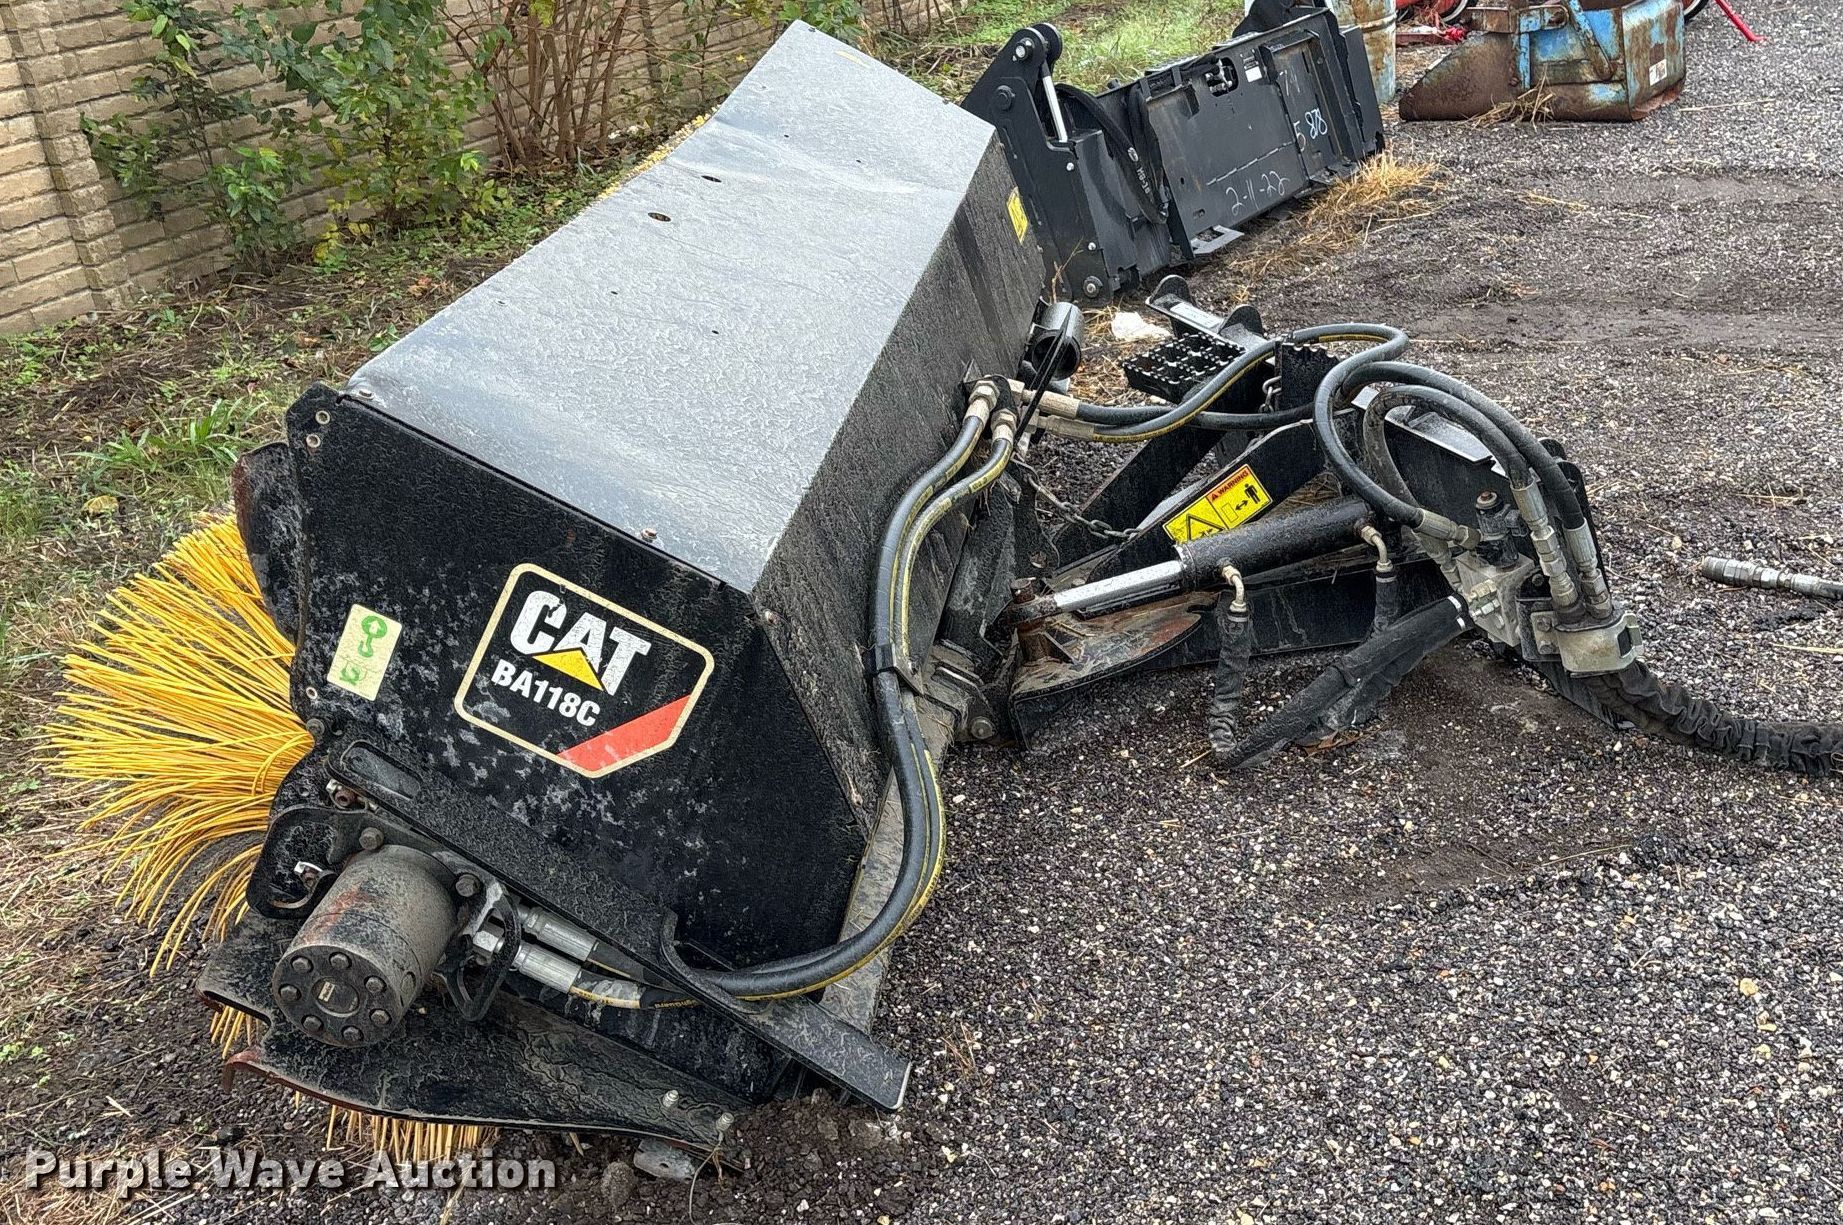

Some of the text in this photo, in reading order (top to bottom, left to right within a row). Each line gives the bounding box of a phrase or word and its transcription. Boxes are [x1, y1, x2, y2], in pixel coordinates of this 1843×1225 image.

[1218, 470, 1249, 496] WARNING
[509, 590, 652, 696] CAT
[490, 659, 602, 727] BA118C
